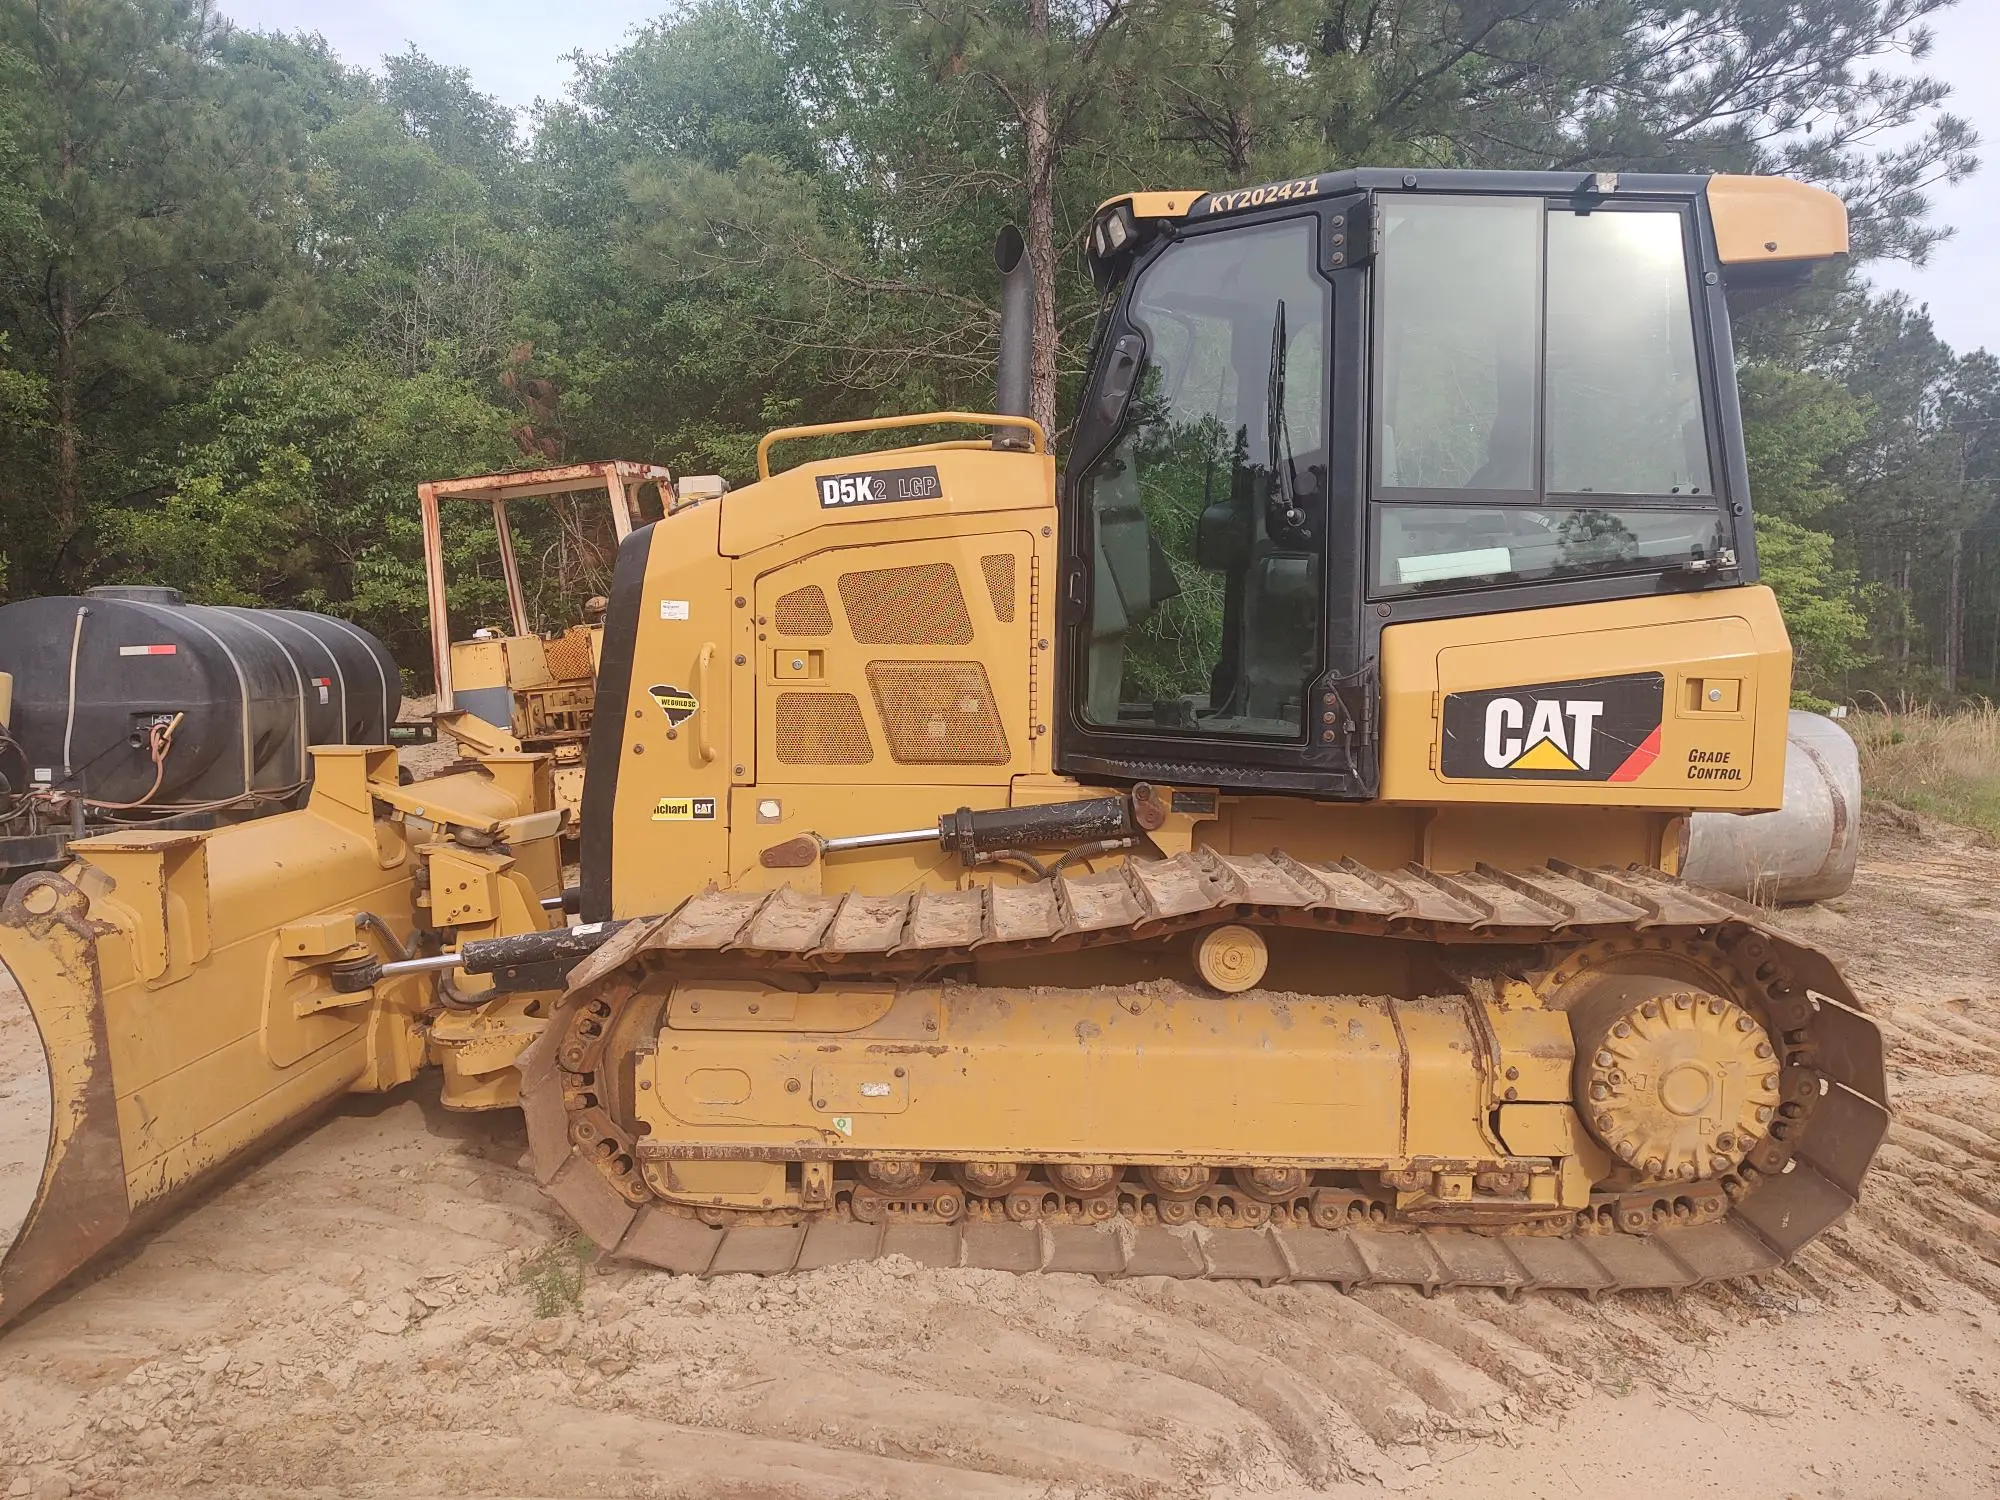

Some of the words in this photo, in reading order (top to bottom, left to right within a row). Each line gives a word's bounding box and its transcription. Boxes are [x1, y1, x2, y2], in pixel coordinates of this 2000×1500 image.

[1209, 178, 1319, 213] KY202421
[898, 476, 937, 498] LGP
[1483, 697, 1604, 771] CAT
[694, 803, 714, 815] CAT
